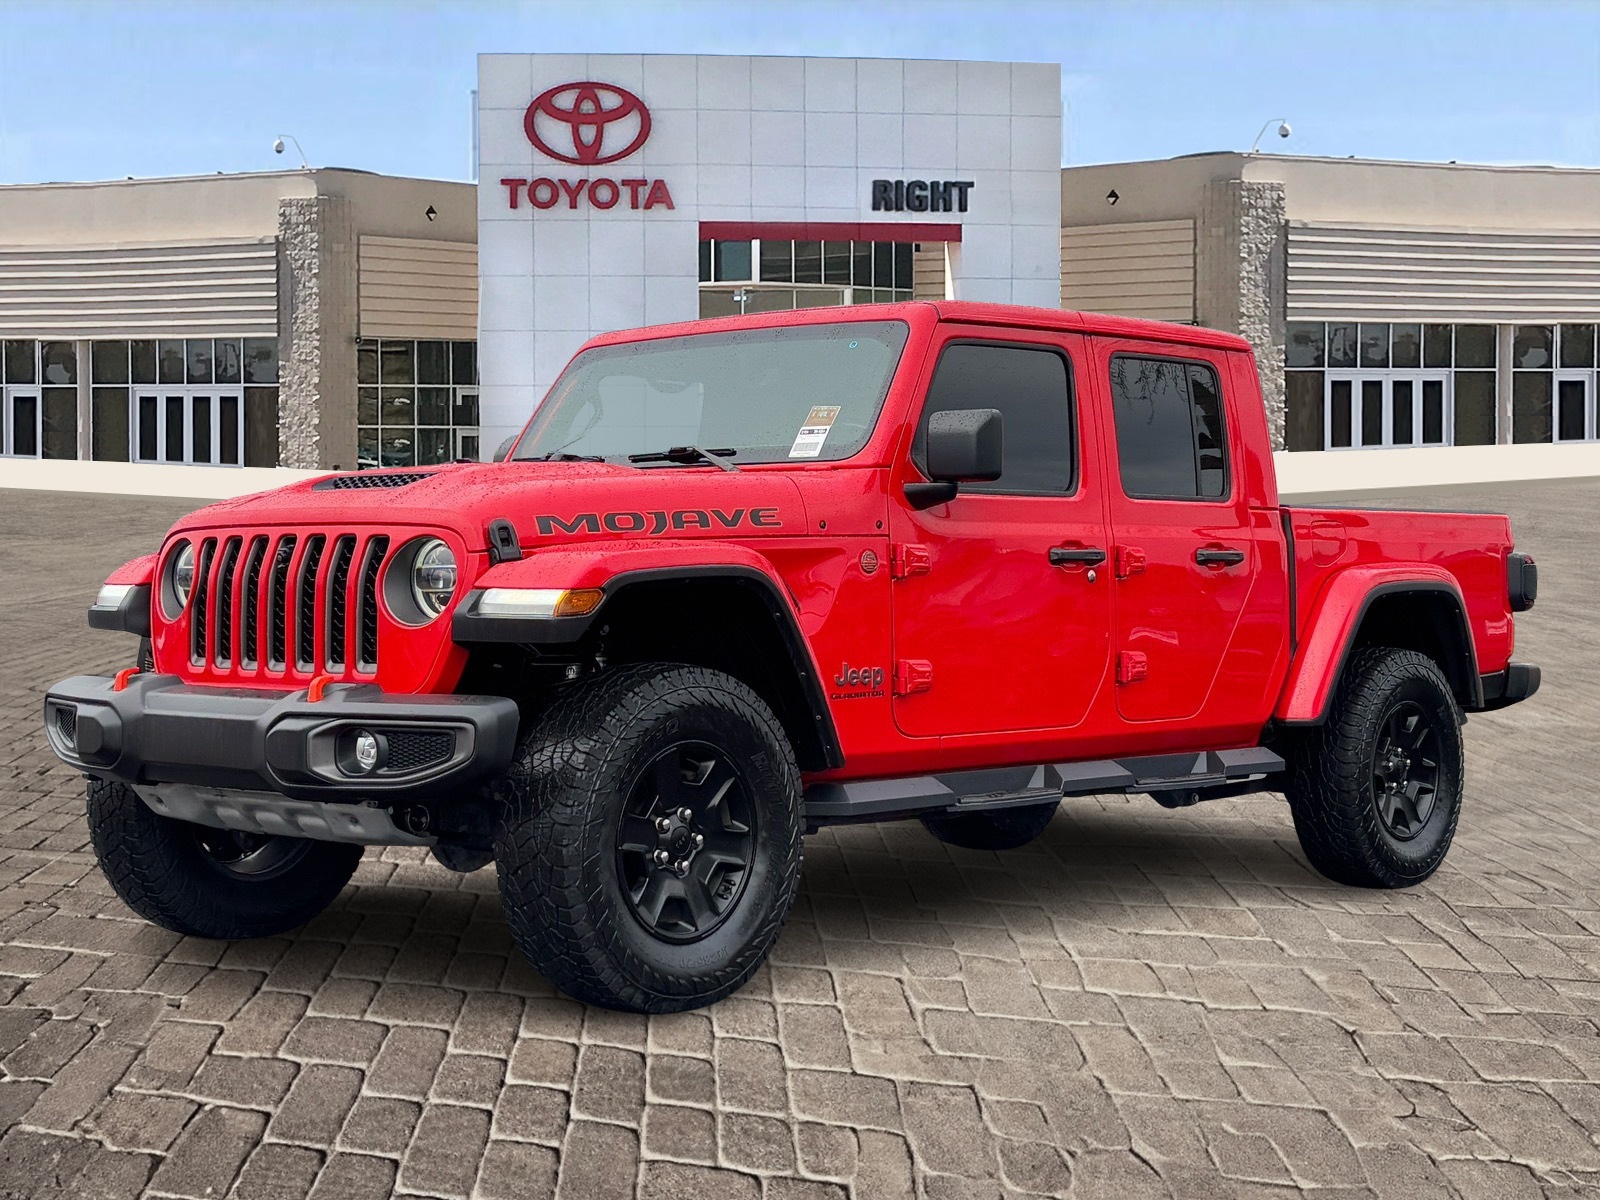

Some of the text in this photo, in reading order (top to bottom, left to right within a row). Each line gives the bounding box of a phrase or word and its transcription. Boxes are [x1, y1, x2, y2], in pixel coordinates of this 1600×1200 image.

[501, 178, 675, 210] TOYOTA
[872, 180, 974, 212] RIGHT
[534, 507, 782, 535] MOJAVE
[834, 661, 884, 690] Jeep
